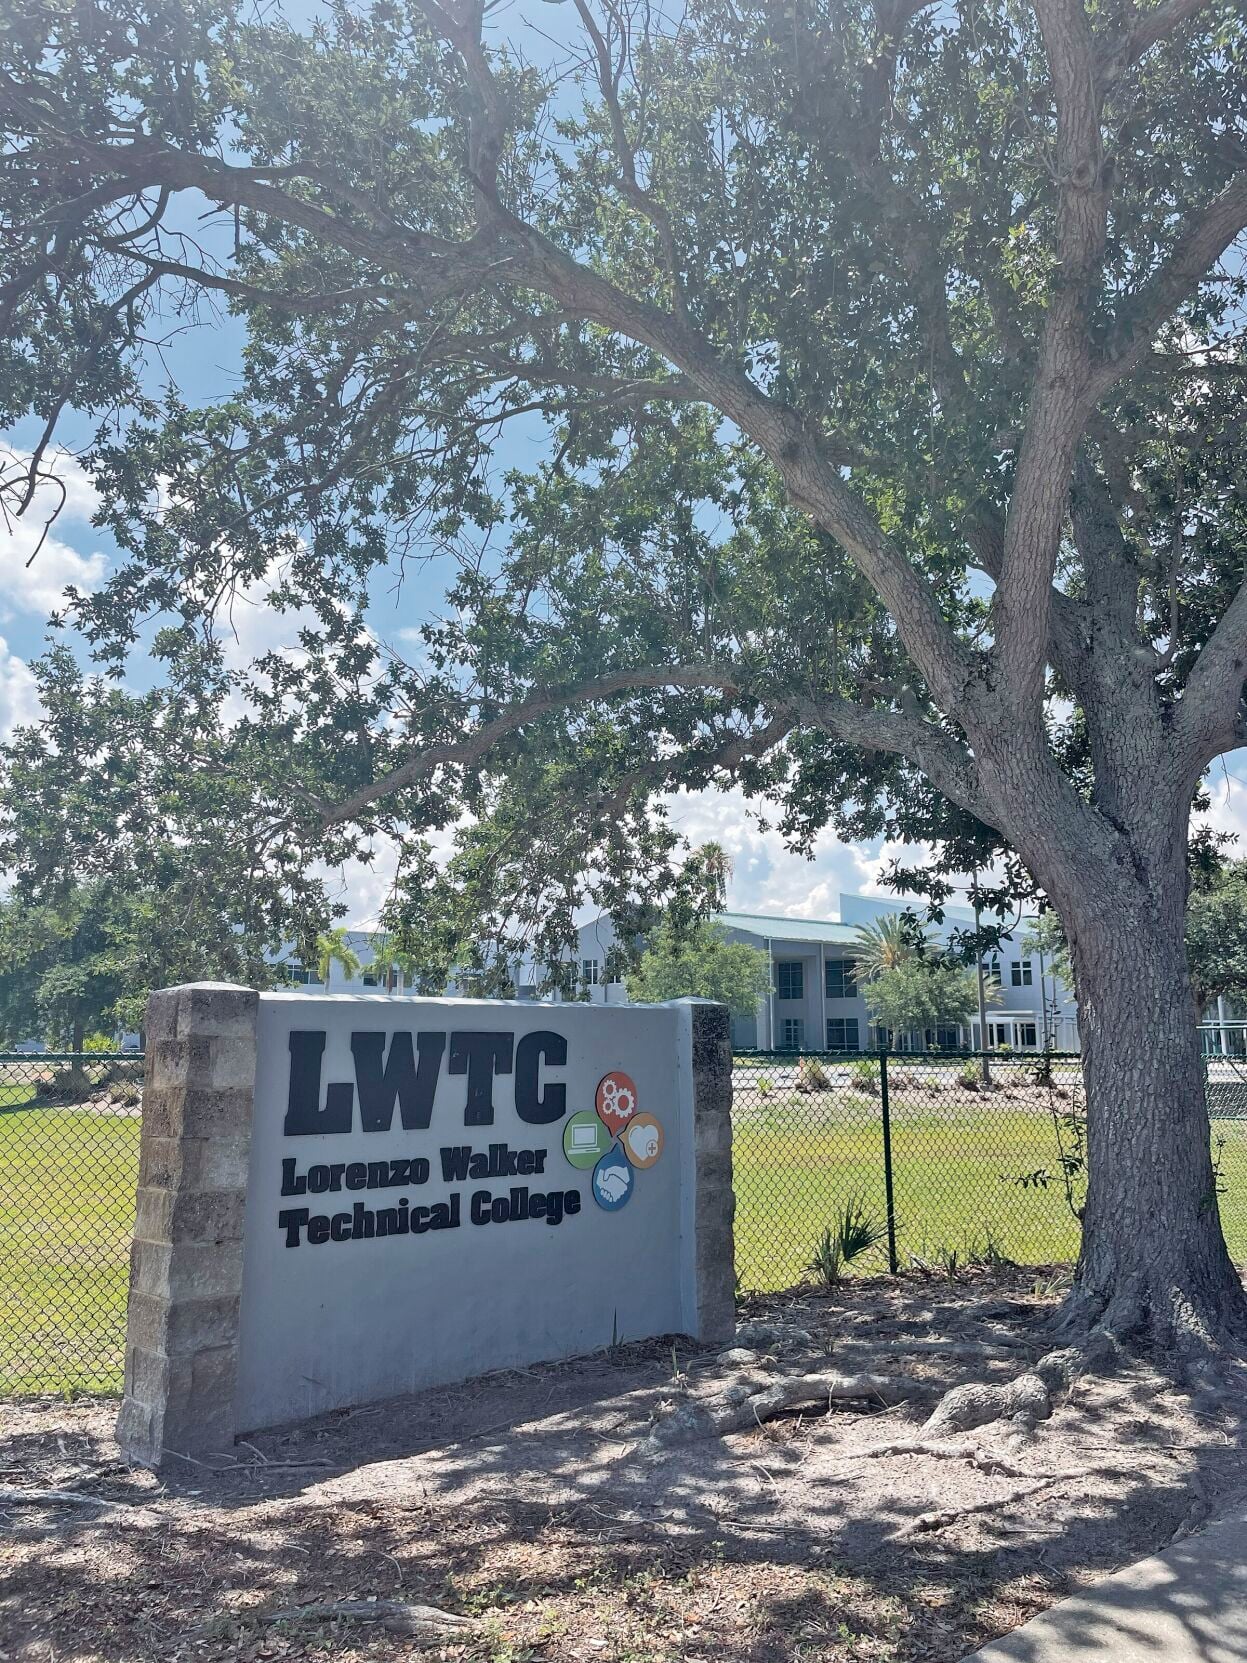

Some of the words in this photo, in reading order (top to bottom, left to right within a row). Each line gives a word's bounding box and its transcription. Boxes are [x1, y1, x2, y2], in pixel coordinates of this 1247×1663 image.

[284, 1031, 567, 1136] LWTC
[281, 1157, 430, 1196] Lorenzo
[440, 1144, 548, 1182] Walker
[279, 1193, 461, 1248] Technical
[470, 1187, 581, 1226] College
